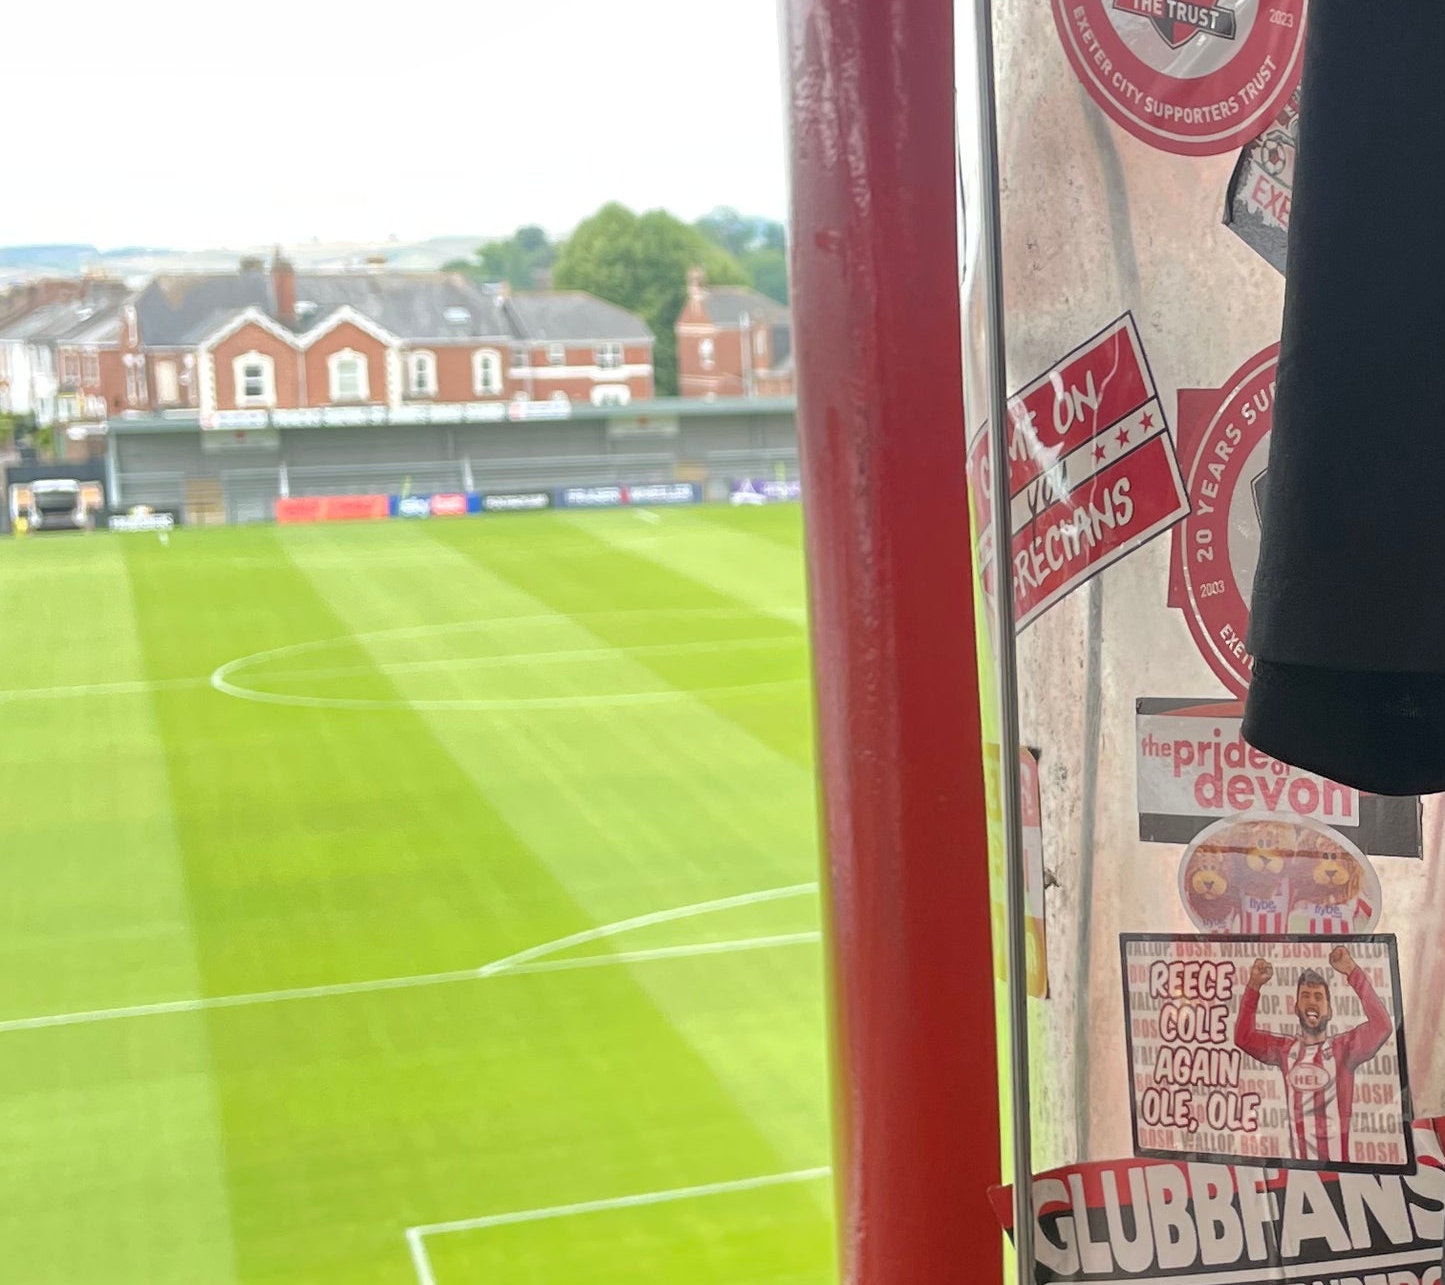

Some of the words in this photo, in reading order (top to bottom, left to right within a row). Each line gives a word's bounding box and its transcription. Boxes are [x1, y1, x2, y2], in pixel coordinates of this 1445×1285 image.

[1072, 5, 1113, 76] EXETER
[1112, 71, 1144, 104] CITY
[1143, 95, 1239, 124] SUPPORTERS
[1238, 54, 1277, 105] TRUST
[1197, 423, 1242, 516] YEARS
[1195, 528, 1214, 563] 20
[1141, 733, 1172, 757] the
[1173, 728, 1270, 778] pride
[1194, 766, 1352, 817] devon
[1149, 959, 1236, 1001] REECE
[1159, 1002, 1229, 1044] COLE
[1153, 1045, 1242, 1088] AGAIN
[1294, 1075, 1321, 1086] HEL
[1141, 1087, 1200, 1134] OLE,
[1206, 1090, 1262, 1132] OLE
